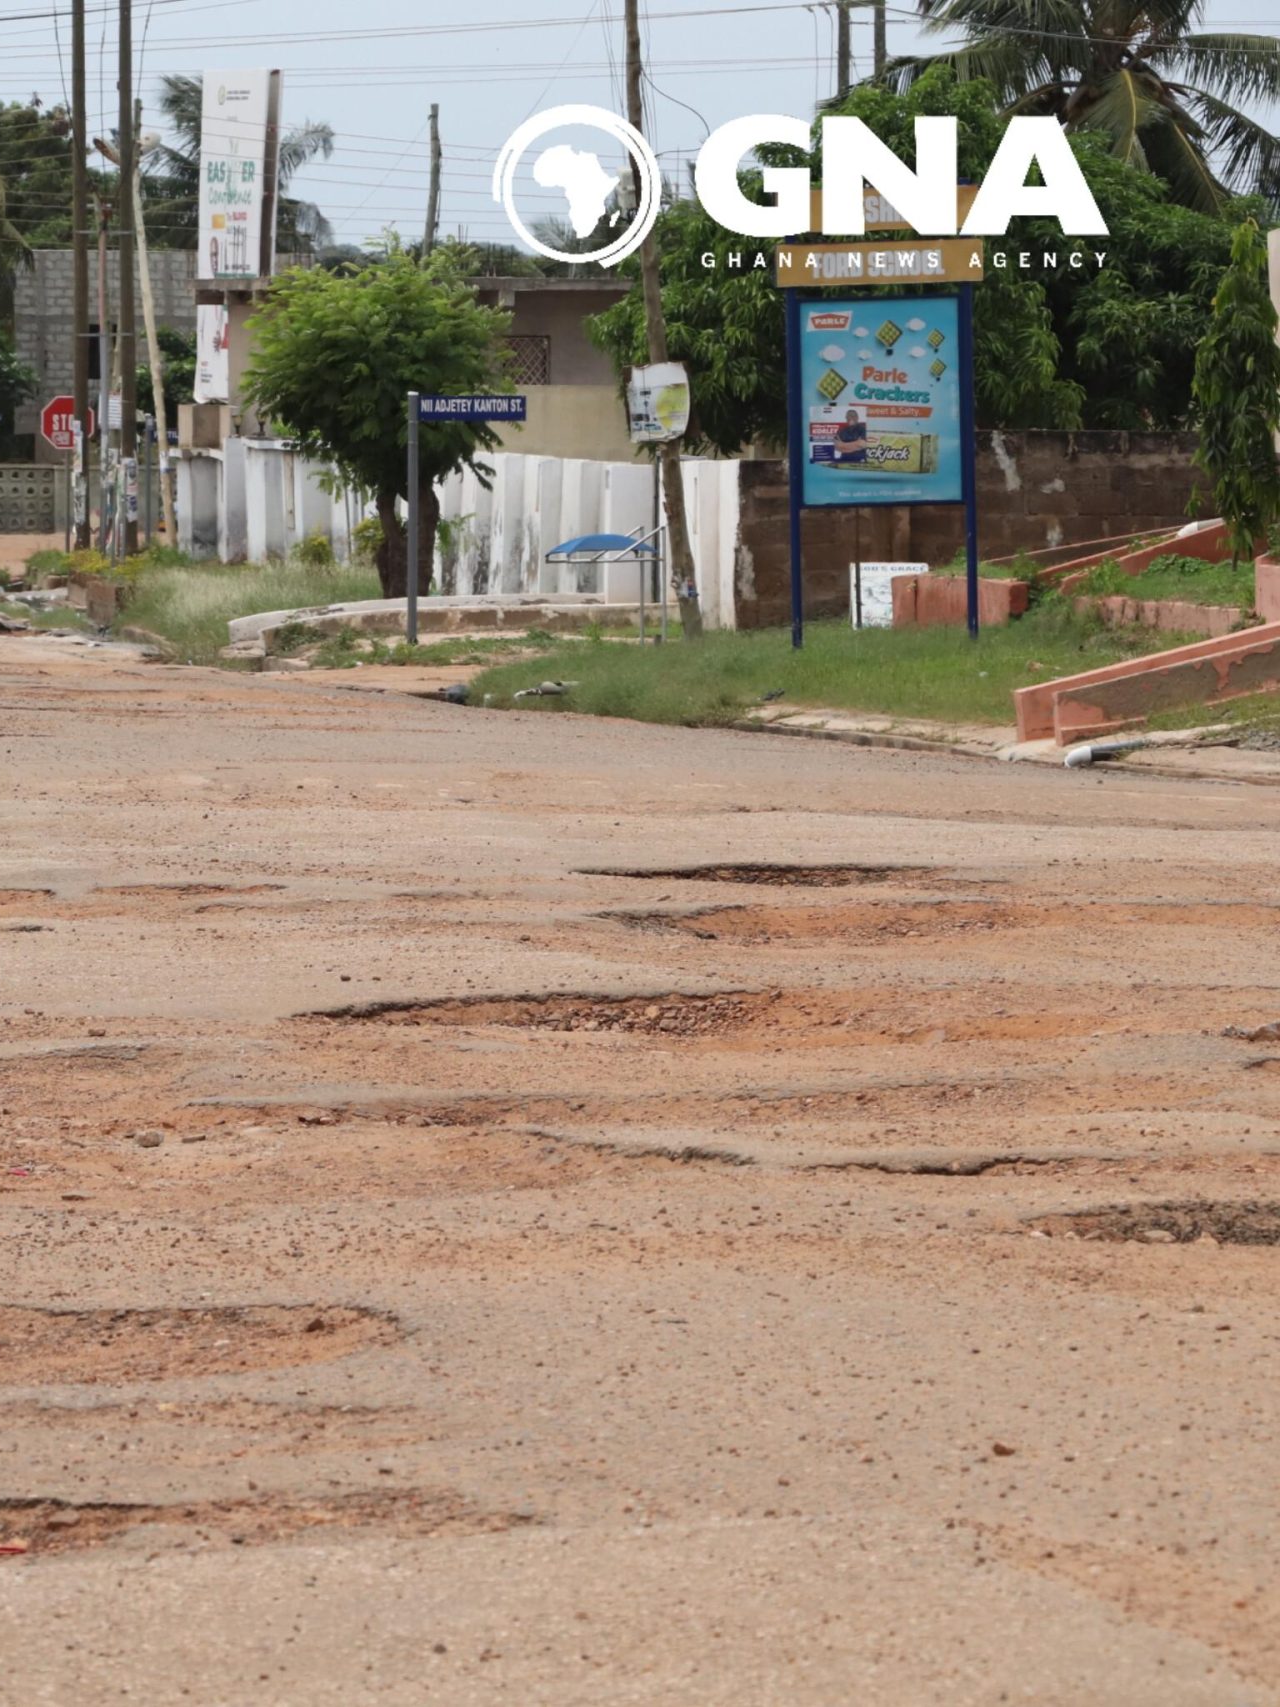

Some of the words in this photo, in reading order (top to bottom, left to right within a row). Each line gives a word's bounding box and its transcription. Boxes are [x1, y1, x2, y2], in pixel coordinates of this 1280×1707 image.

[207, 161, 255, 183] EASER
[867, 248, 945, 276] SCHOOL
[815, 317, 845, 325] PARLE
[862, 366, 907, 384] Parle
[854, 383, 930, 404] Crackers
[421, 400, 433, 412] NII
[435, 400, 471, 412] ADJETEY
[474, 400, 508, 412] KANTON
[52, 413, 75, 431] STO
